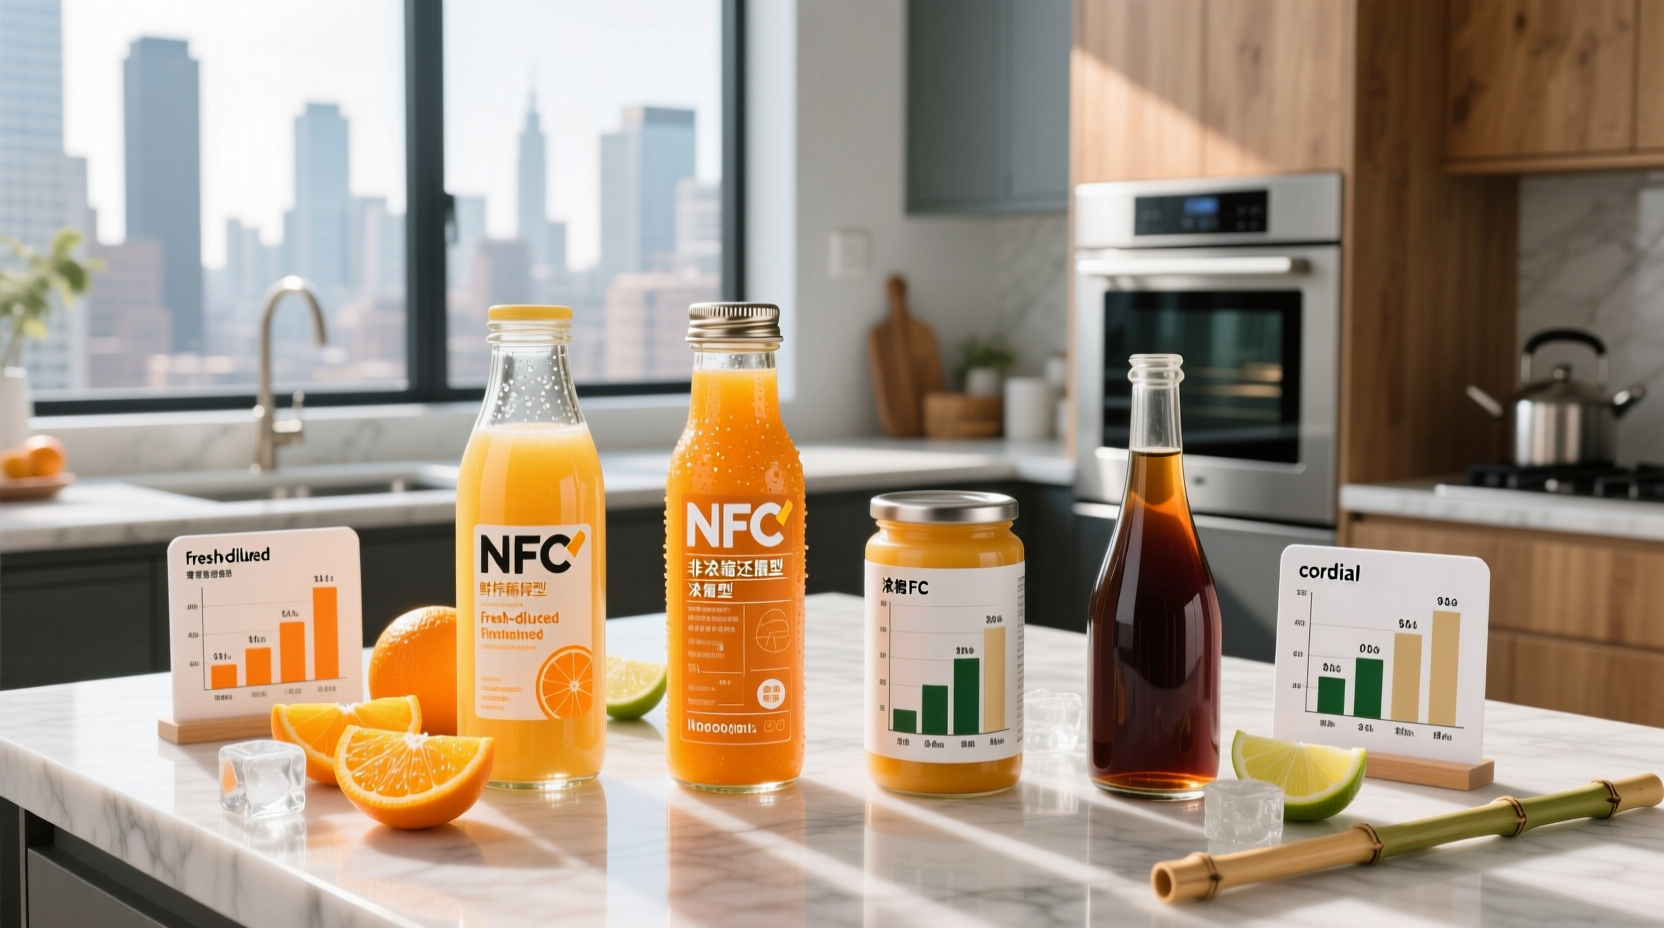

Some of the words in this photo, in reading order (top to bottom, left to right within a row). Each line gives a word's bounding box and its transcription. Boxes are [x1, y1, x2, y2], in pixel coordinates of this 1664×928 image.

[686, 501, 785, 548] NFC
[480, 533, 572, 574] NFC
[1299, 563, 1360, 582] cordial
